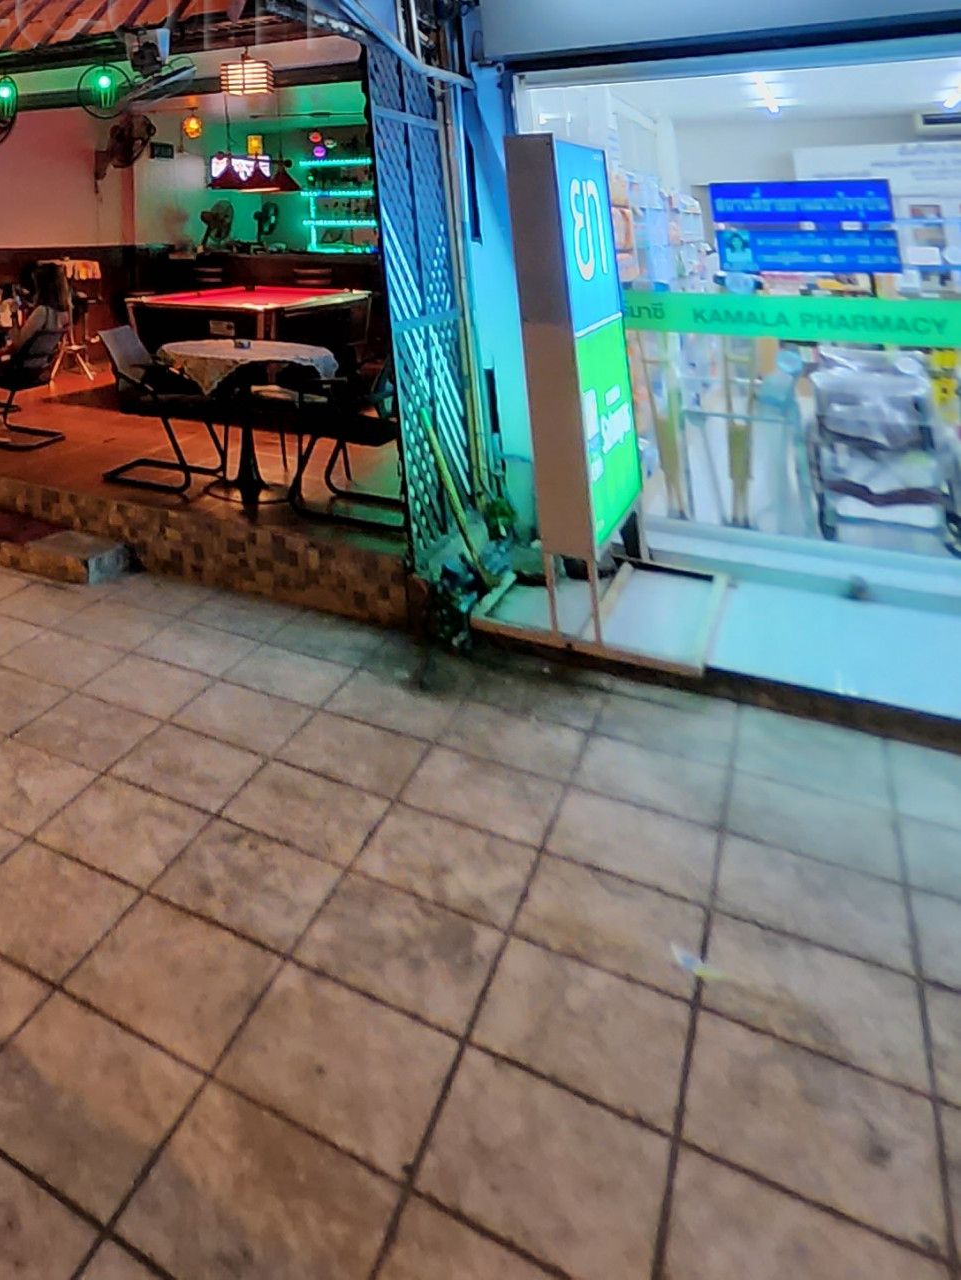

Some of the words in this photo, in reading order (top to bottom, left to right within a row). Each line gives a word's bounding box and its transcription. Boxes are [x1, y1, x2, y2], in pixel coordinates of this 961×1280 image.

[570, 178, 609, 282] ยา
[693, 308, 791, 327] KAMALA
[799, 312, 950, 335] PHARMACY
